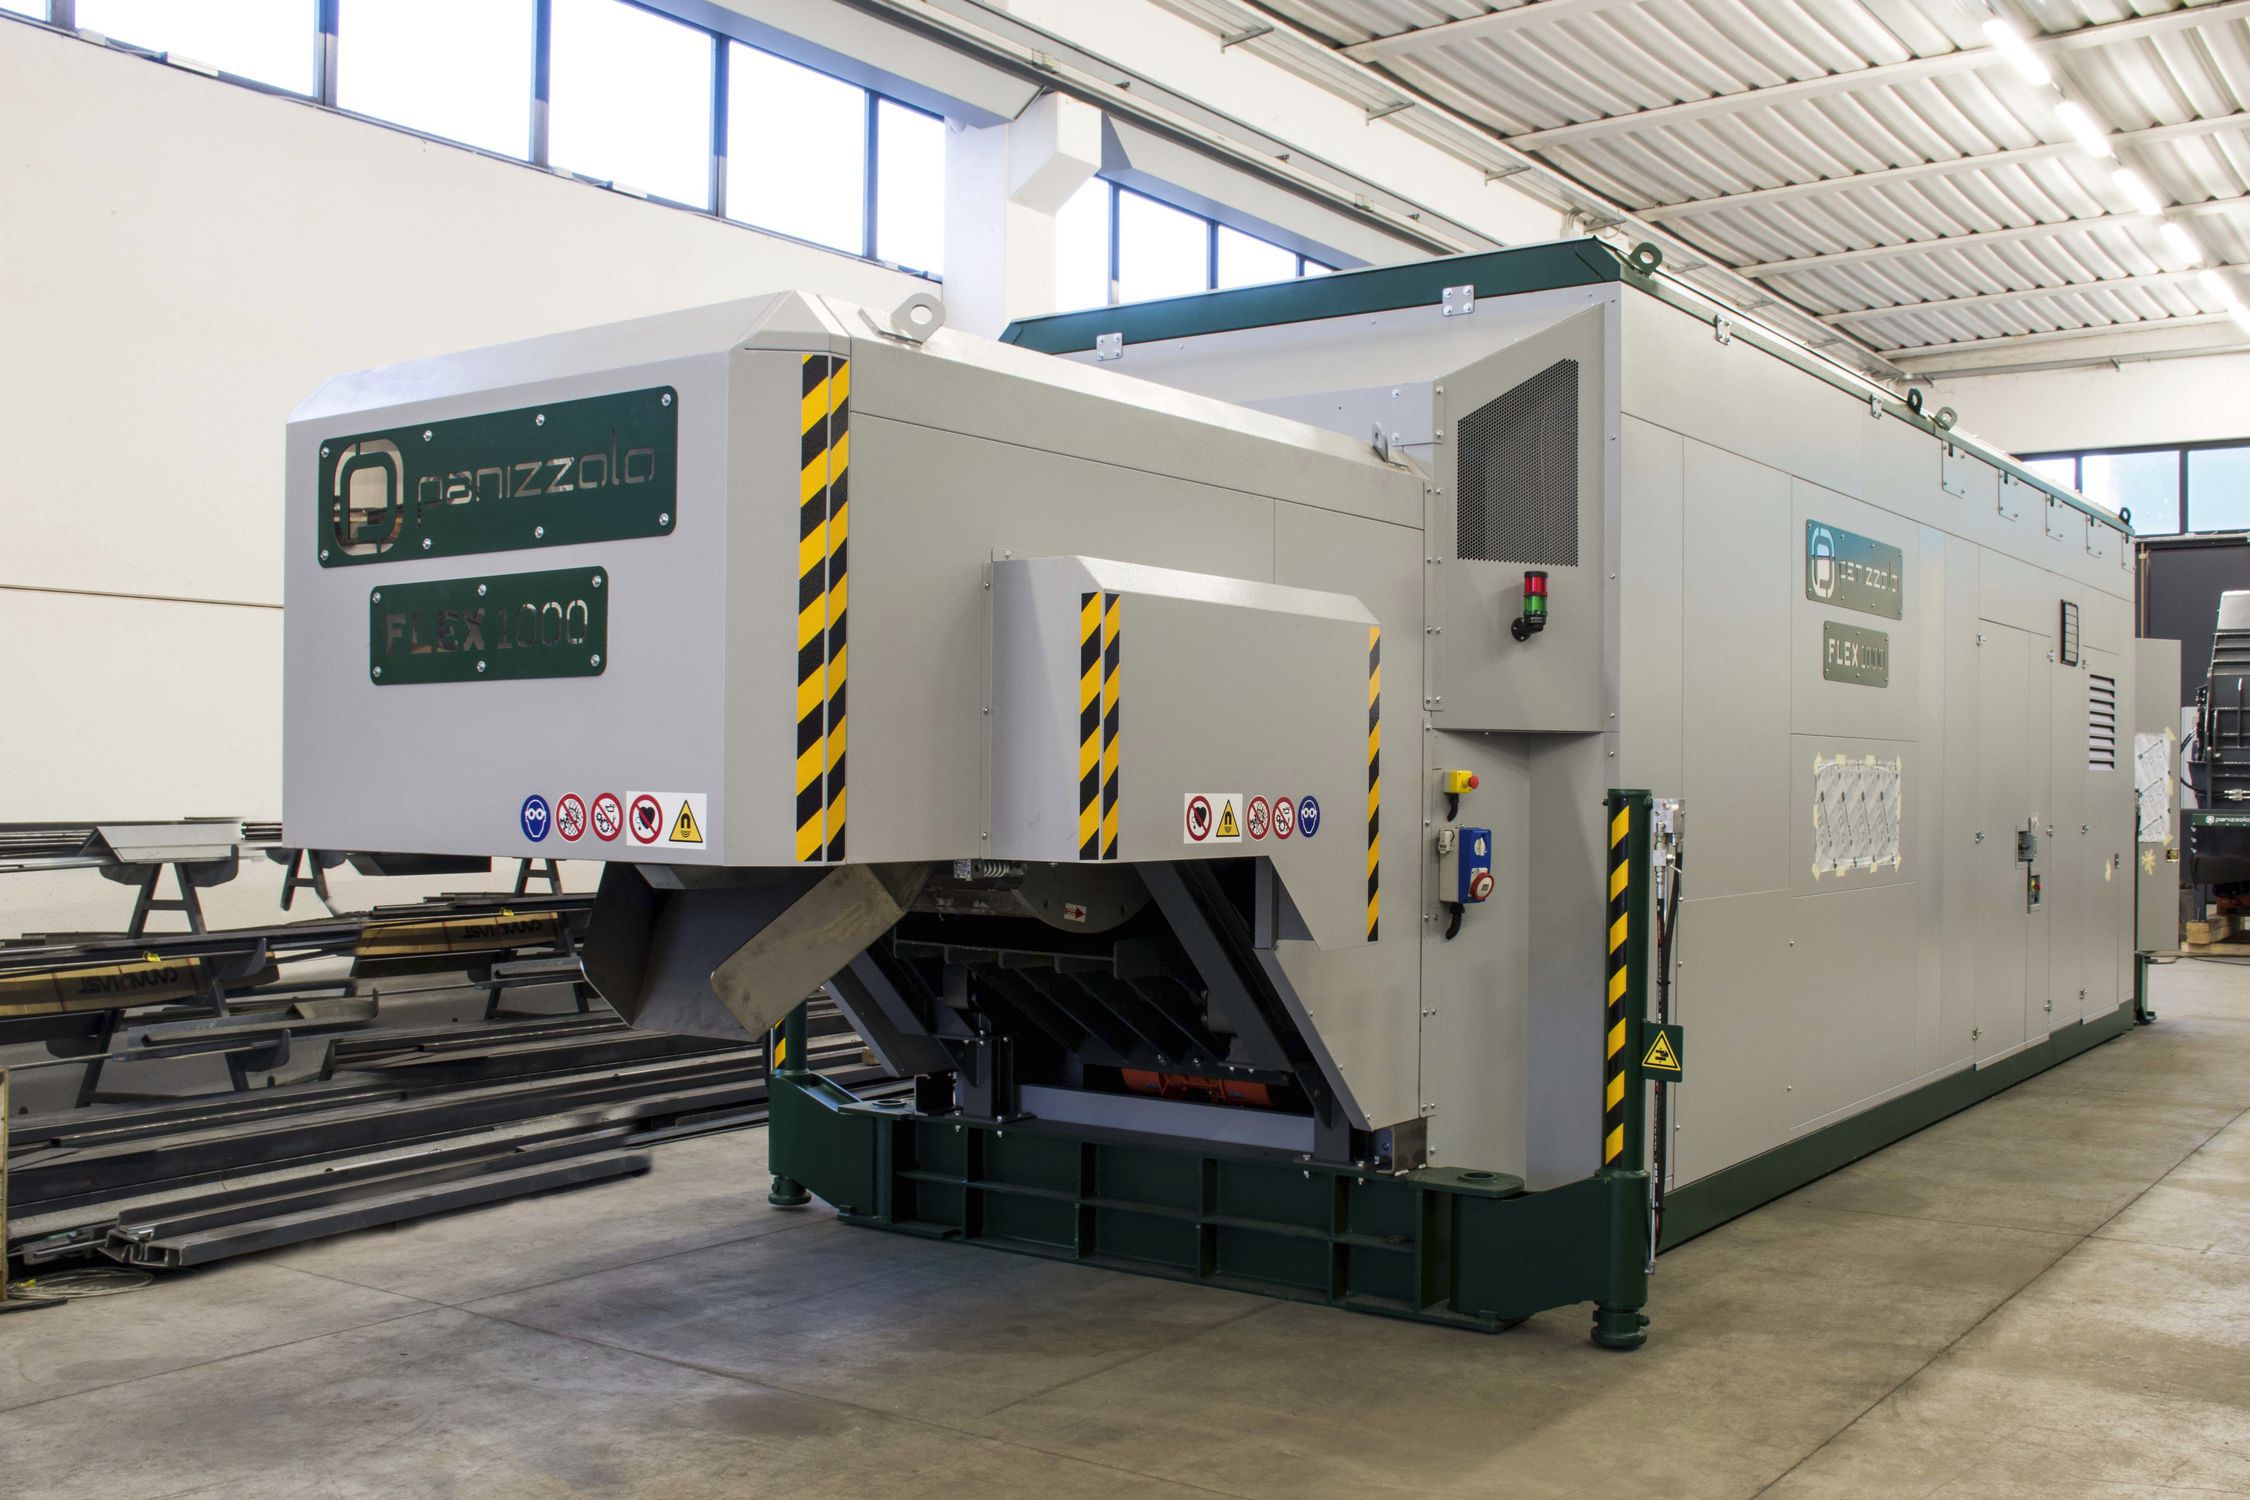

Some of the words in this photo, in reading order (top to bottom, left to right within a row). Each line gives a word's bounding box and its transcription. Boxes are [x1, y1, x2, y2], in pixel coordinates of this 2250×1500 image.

[417, 428, 655, 528] panizzolo
[384, 607, 486, 656] FLEX
[497, 600, 588, 649] 1000
[1828, 639, 1859, 667] FLEX
